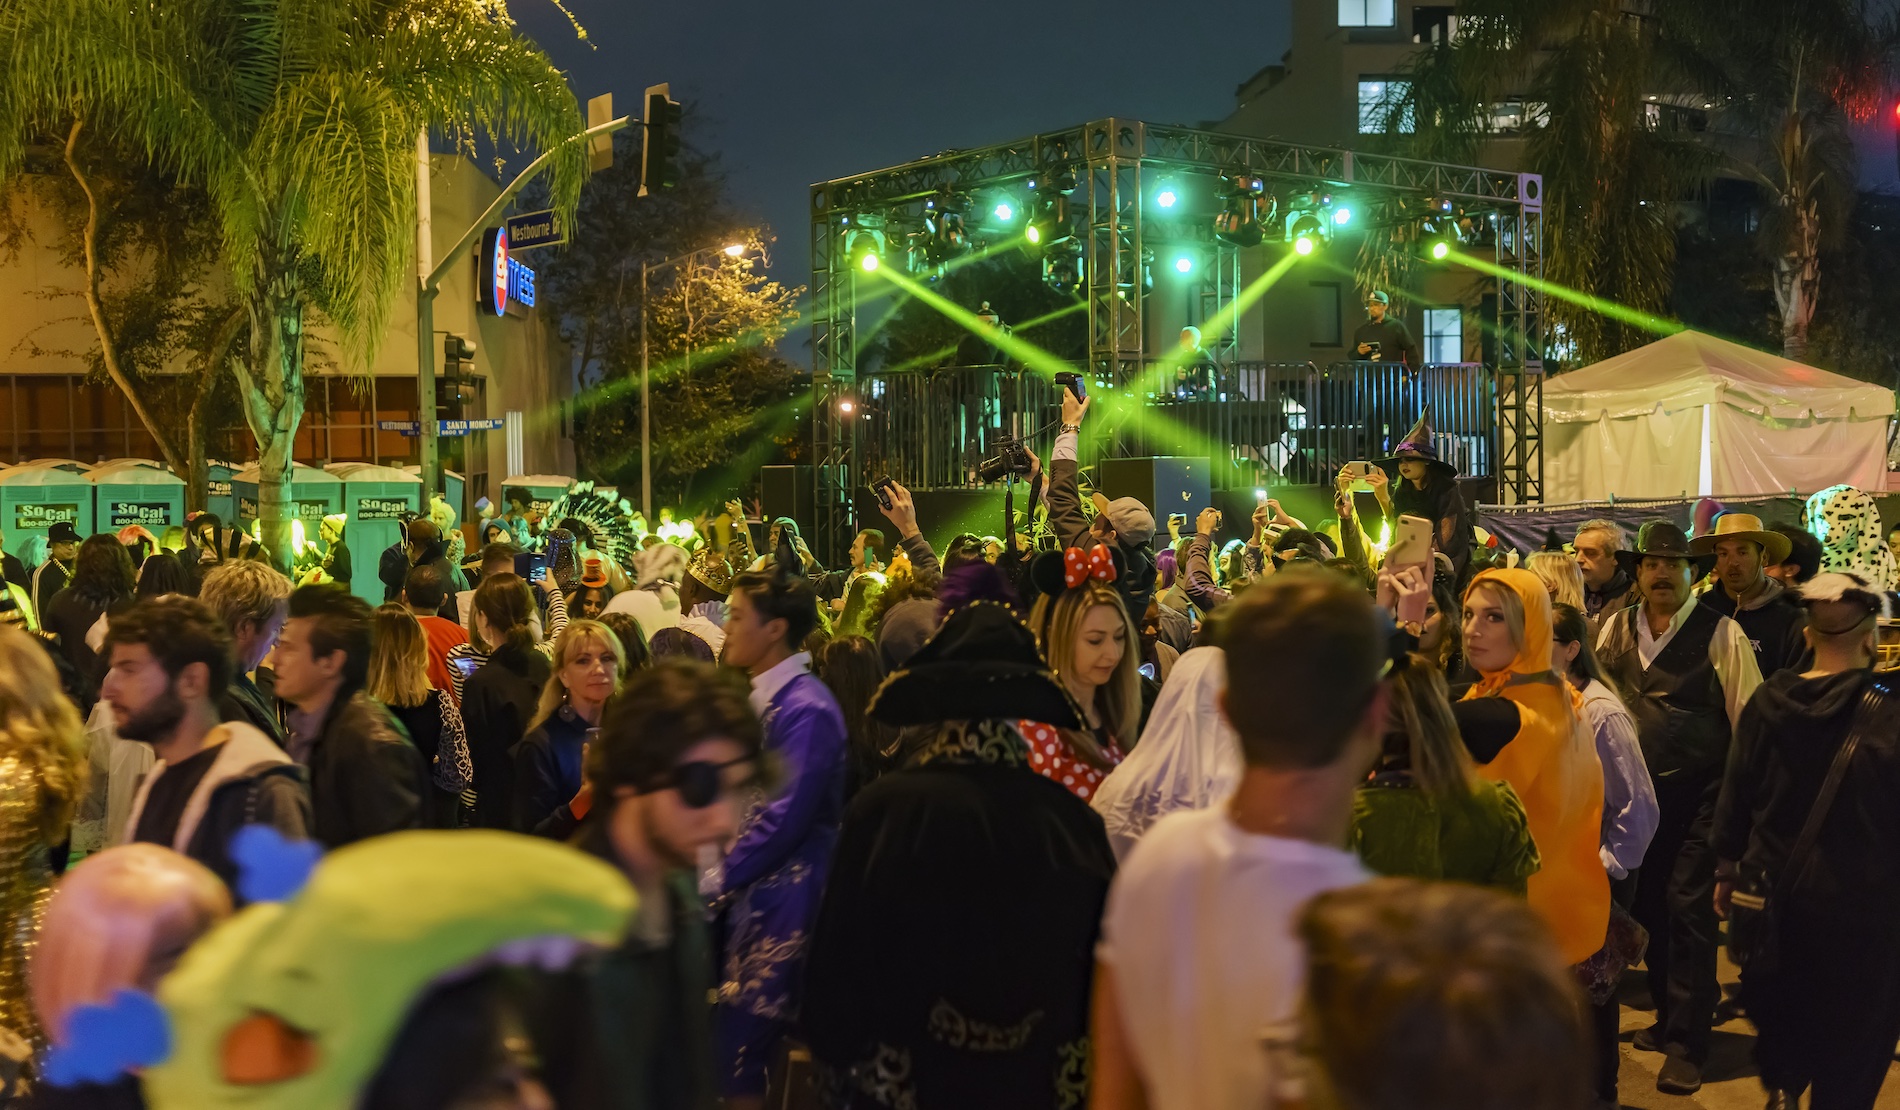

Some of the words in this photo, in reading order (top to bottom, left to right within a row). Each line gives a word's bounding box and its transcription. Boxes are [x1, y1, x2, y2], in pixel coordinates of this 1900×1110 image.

[511, 222, 550, 241] Westbourne
[507, 256, 535, 308] TNESS
[381, 421, 413, 430] WESTBOURNE
[446, 420, 468, 430] SANTA
[469, 419, 494, 430] MONICA
[215, 482, 231, 491] Cal
[117, 502, 138, 515] So
[139, 506, 164, 519] Cal
[300, 503, 323, 515] Cal
[360, 499, 381, 509] So
[381, 501, 406, 512] Cal
[22, 504, 44, 517] So
[45, 508, 71, 520] Cal
[20, 519, 73, 528] 800-850-
